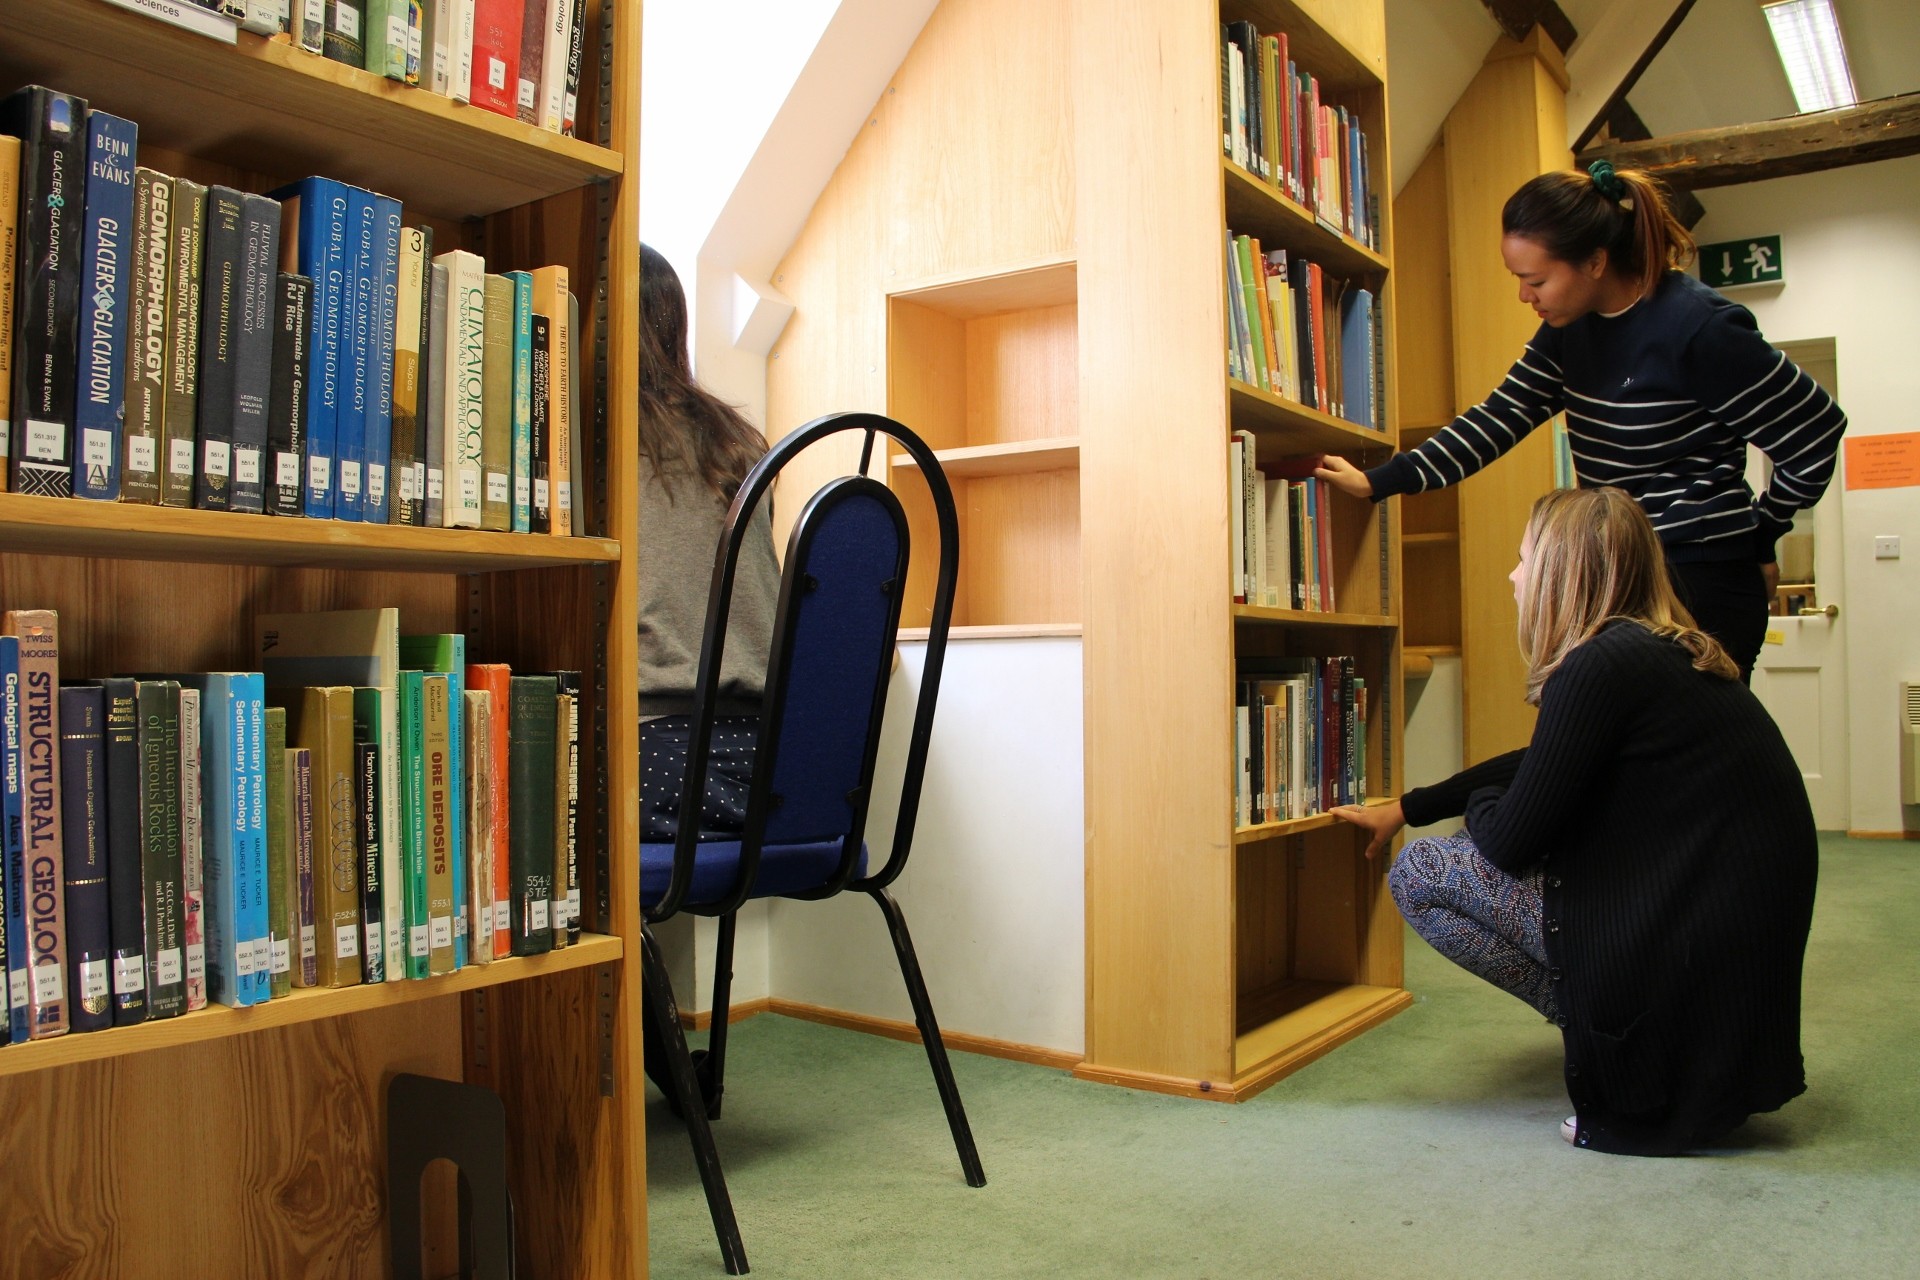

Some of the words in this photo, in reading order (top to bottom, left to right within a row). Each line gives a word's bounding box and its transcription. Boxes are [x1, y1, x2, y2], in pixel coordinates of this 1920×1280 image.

[569, 26, 582, 76] geology
[489, 96, 508, 109] NELSON
[97, 134, 130, 158] BENN
[104, 152, 120, 168] &
[51, 150, 64, 200] GLACIERS
[92, 161, 131, 186] EVANS
[140, 177, 149, 185] A
[48, 193, 65, 207] &
[136, 188, 150, 230] Systematic
[193, 197, 201, 223] COOKE
[49, 207, 61, 270] GLACIATION
[250, 221, 260, 233] IN
[330, 197, 347, 262] GLOBAL
[360, 206, 376, 271] GLOBAL
[95, 217, 119, 292] GLACIERS
[135, 233, 148, 266] Analysis
[190, 231, 199, 278] DOORNKAMP
[258, 223, 271, 268] FLUVIAL
[386, 213, 402, 276] GLOBAL
[135, 268, 147, 277] of
[146, 182, 169, 386] GEOMORPHOLOGY
[177, 226, 191, 314] ENVIRONMENTAL
[244, 237, 259, 334] GEOMORPHOLOGY
[410, 260, 420, 288] Young
[48, 279, 56, 307] SECOND
[136, 279, 147, 296] Late
[256, 272, 268, 330] PROCESSES
[286, 282, 299, 300] RJ
[312, 262, 322, 334] SUMMERFIELD
[134, 298, 146, 336] Cenozoic
[217, 261, 232, 363] GEOMORPHOLOGY
[285, 304, 298, 331] Rice
[343, 269, 353, 340] SUMMERFIELD
[369, 275, 380, 345] SUMMERFIELD
[520, 282, 531, 336] Lockwood
[46, 308, 55, 337] EDITION
[187, 283, 199, 381] GEOMORPHOLOGY
[294, 284, 307, 360] Fundamentals
[459, 286, 470, 367] FUNDAMENTALS
[324, 270, 343, 408] GEOMORPHOLOGY
[354, 277, 372, 414] GEOMORPHOLOGY
[380, 283, 398, 418] GEOMORPHOLOGY
[44, 354, 54, 376] BENN
[91, 308, 114, 404] GLACIATION
[133, 338, 145, 382] Landforms
[175, 318, 188, 394] MANAGEMENT
[294, 364, 303, 376] of
[560, 358, 567, 368] TO
[186, 383, 195, 394] IN
[407, 357, 416, 392] Slopes
[458, 369, 468, 394] AND
[465, 288, 485, 469] CLIMATOLOGY
[560, 369, 568, 393] EARTH
[43, 386, 53, 412] EVANS
[143, 387, 152, 422] ARTHUR
[559, 394, 568, 424] HISTORY
[289, 379, 303, 453] Geomorpholo
[457, 397, 467, 465] APPLICATIONS
[34, 433, 57, 442] 551.312
[38, 447, 52, 455] BEN
[89, 440, 106, 448] 551.31
[91, 453, 104, 461] BEN
[207, 495, 226, 504] Oxford
[20, 649, 58, 658] MOORES
[26, 635, 55, 643] TWISS
[5, 673, 19, 749] Geological
[412, 686, 421, 721] Anderson
[429, 685, 437, 722] MacDiarmid
[568, 697, 579, 742] LUNAR
[148, 715, 164, 732] of
[165, 715, 178, 747] The
[236, 700, 247, 773] Sedimentary
[251, 699, 262, 771] Sedimentary
[413, 730, 422, 751] Owen
[5, 753, 18, 793] maps
[28, 670, 55, 850] STRUCTURAL
[87, 749, 95, 790] Non-marine
[145, 738, 164, 800] Igneous
[365, 751, 376, 784] Hamlyn
[431, 751, 443, 786] ORE
[569, 745, 579, 805] SCIENCE:
[301, 766, 311, 800] Minerals
[366, 785, 374, 812] nature
[414, 773, 422, 807] Structure
[86, 792, 96, 818] Organic
[163, 750, 180, 858] Interpretation
[235, 776, 248, 833] Petrology
[251, 774, 264, 830] Petrology
[302, 802, 310, 815] and
[415, 808, 423, 817] of
[11, 814, 22, 847] Alex
[149, 803, 165, 853] Rocks
[303, 817, 311, 829] the
[364, 814, 375, 841] guides
[415, 818, 423, 830] the
[432, 789, 446, 876] DEPOSITS
[568, 819, 577, 837] Post
[87, 820, 97, 866] Geochemistry
[254, 837, 262, 868] MAURICE
[302, 831, 312, 874] Microscope
[415, 831, 424, 856] British
[567, 838, 577, 864] Apollo
[366, 842, 379, 892] Minerals
[415, 857, 424, 874] Isles
[527, 874, 551, 887] 554.2
[568, 865, 577, 887] View
[11, 851, 23, 918] Maltman
[155, 880, 165, 895] and
[240, 882, 248, 910] TUCKER
[255, 878, 263, 907] TUCKER
[528, 887, 548, 898] STE
[162, 960, 177, 968] 552.1
[189, 954, 203, 962] 552.4
[39, 976, 56, 985] 551.8
